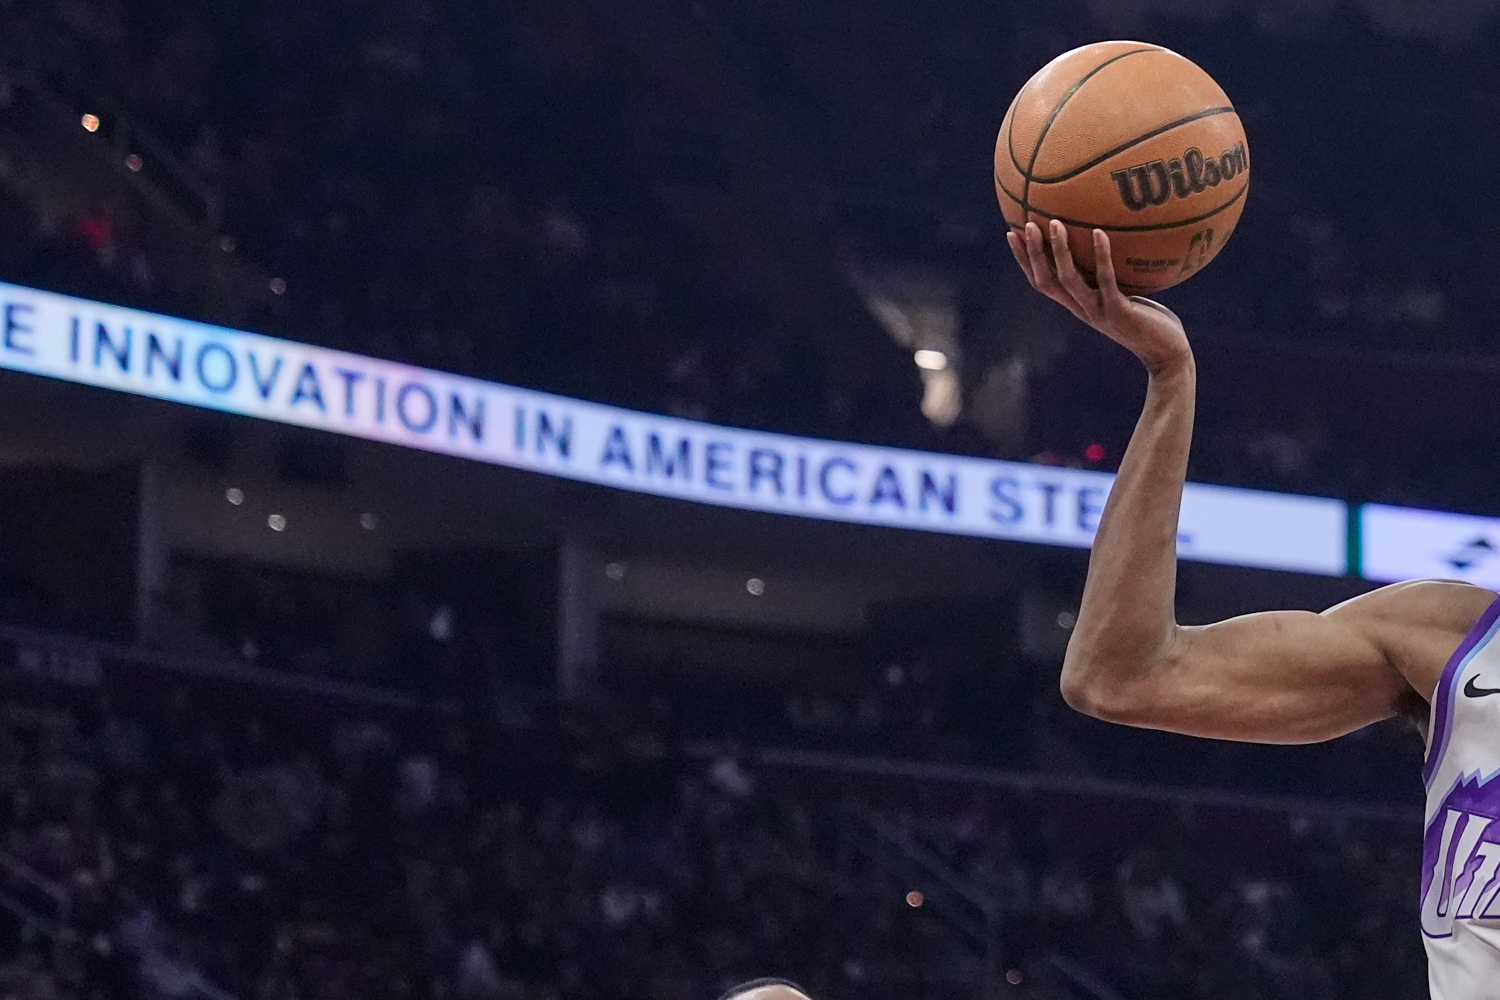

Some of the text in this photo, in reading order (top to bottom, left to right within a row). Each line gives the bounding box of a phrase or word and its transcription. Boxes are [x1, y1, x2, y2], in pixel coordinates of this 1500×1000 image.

[1110, 140, 1249, 212] Wilson
[69, 315, 486, 444] INNOVATION
[513, 405, 574, 459] IN
[601, 425, 957, 513] AMERICAN
[990, 477, 1193, 544] STE
